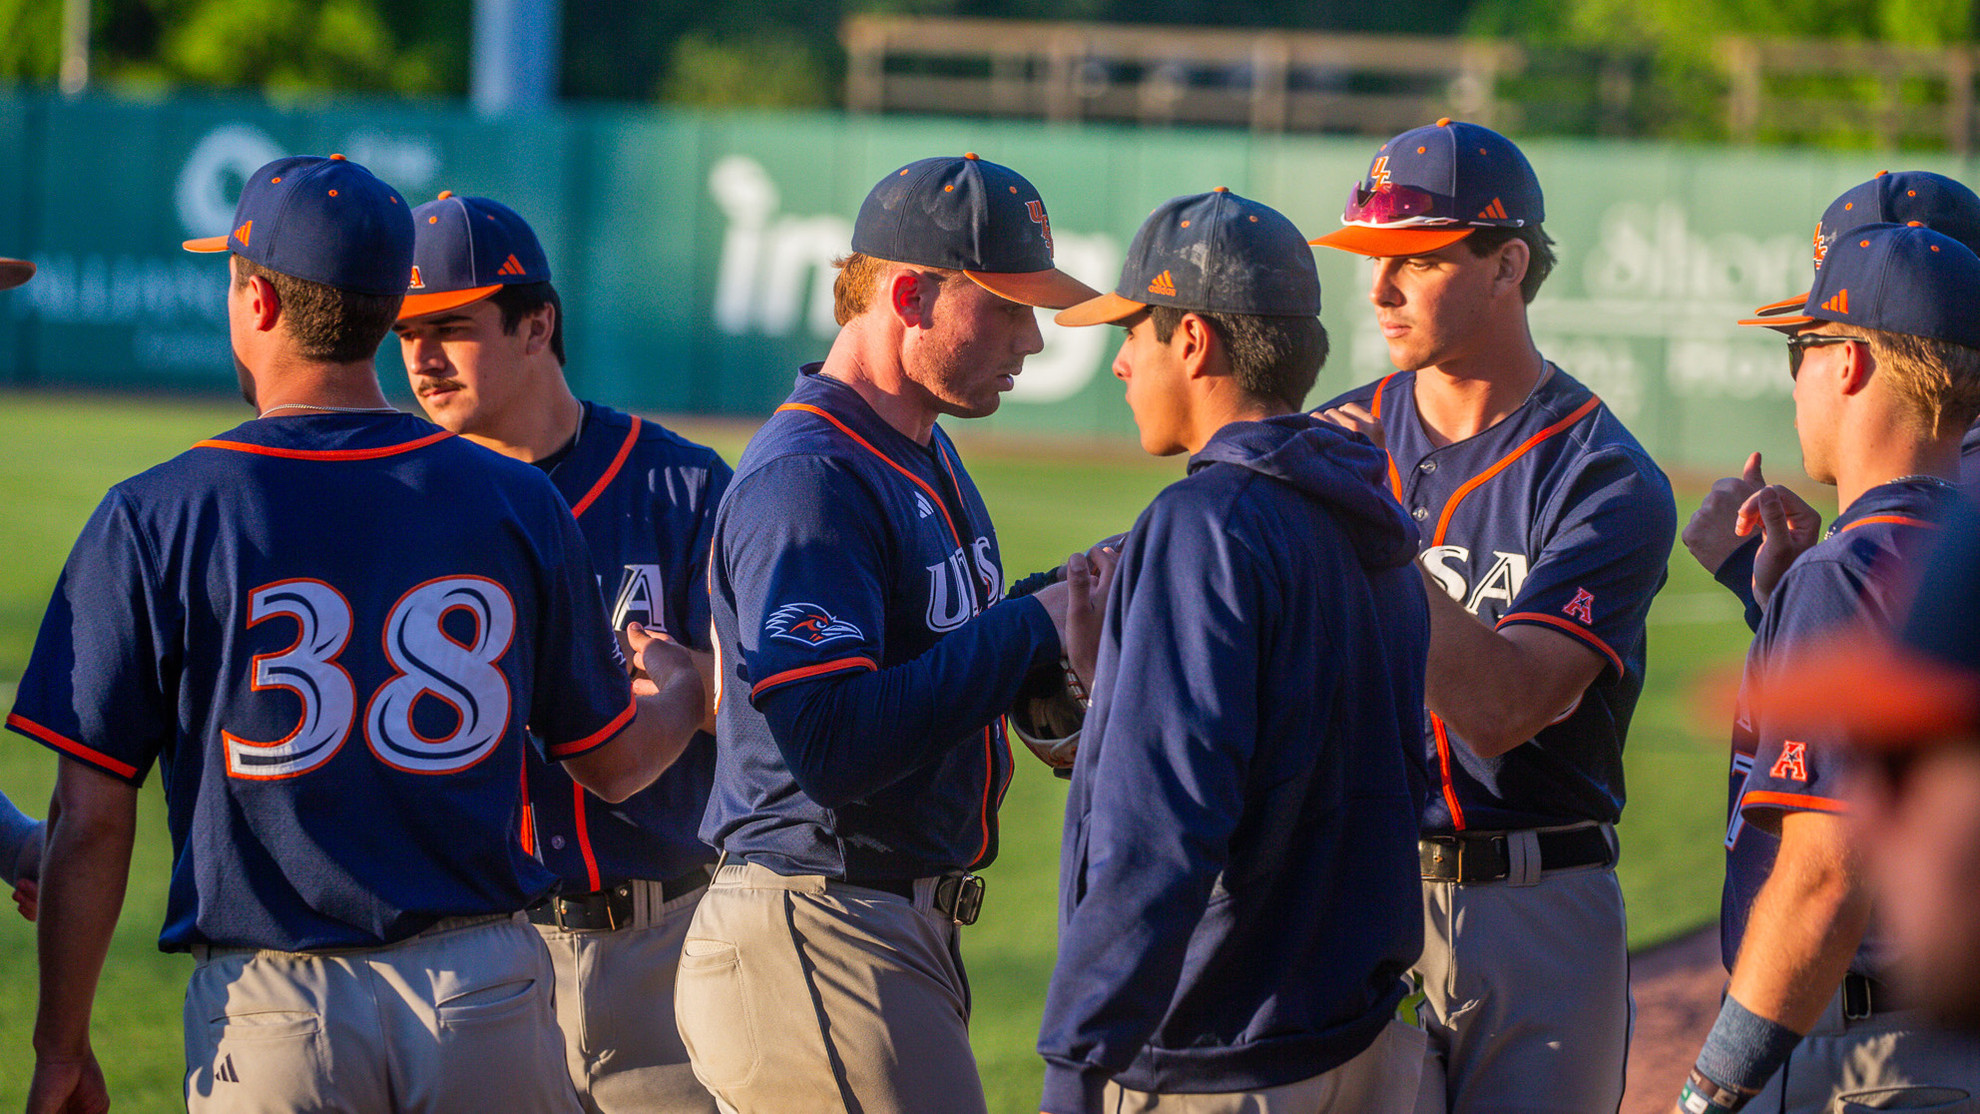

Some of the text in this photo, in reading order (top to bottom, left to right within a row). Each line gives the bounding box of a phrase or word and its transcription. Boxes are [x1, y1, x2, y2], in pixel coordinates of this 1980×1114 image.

[595, 564, 668, 632] A
[926, 536, 1006, 633] UTS
[221, 574, 516, 781] 38
